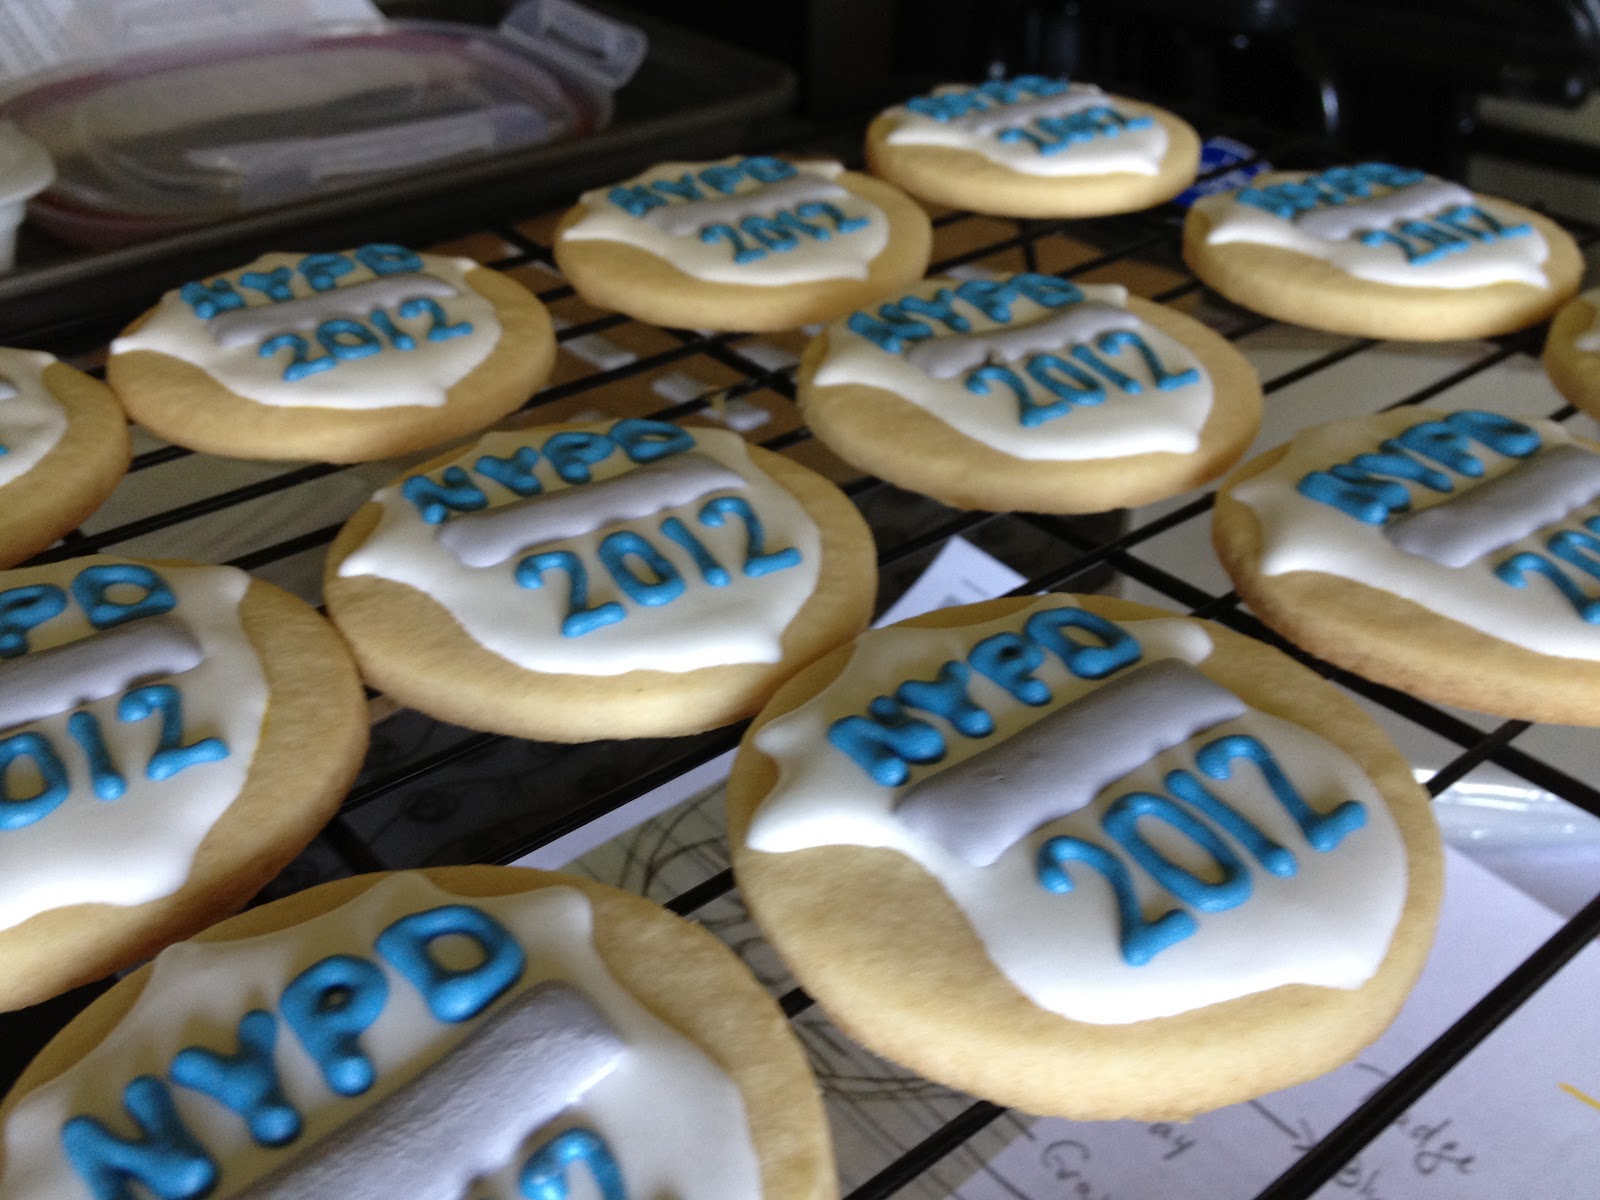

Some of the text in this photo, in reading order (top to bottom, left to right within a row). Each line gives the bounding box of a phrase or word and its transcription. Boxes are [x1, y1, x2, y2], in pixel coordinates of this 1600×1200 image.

[180, 243, 424, 320] NYPD
[701, 203, 871, 264] 2012
[1360, 204, 1533, 266] 2012
[259, 296, 476, 382] 2012
[847, 272, 1085, 354] NYPD
[966, 331, 1200, 427] 2012
[402, 418, 696, 525] NYPD
[1297, 410, 1541, 526] NYPD
[515, 496, 803, 638] 2012
[827, 606, 1142, 788] NYPD
[1038, 734, 1368, 967] 2012
[60, 903, 525, 1200] NYPD
